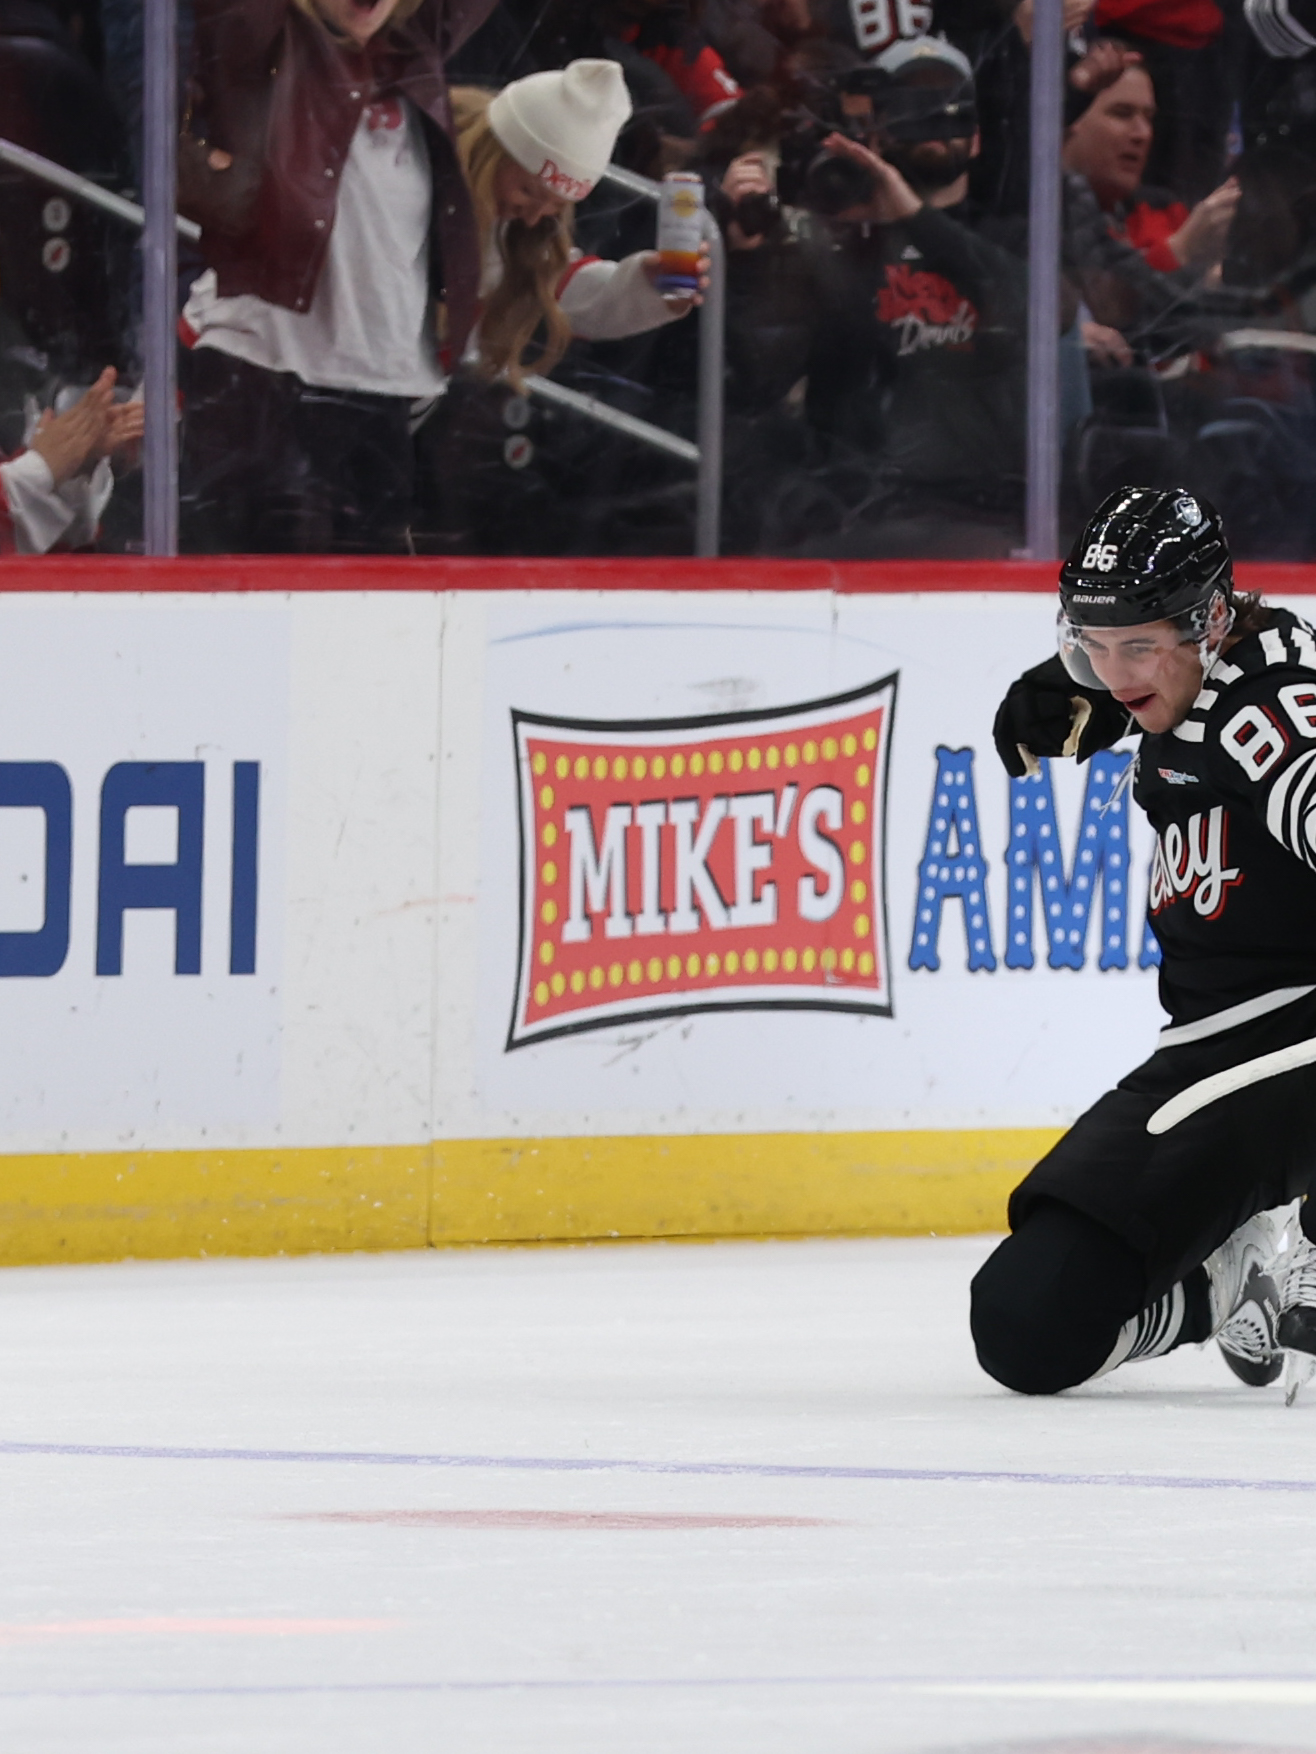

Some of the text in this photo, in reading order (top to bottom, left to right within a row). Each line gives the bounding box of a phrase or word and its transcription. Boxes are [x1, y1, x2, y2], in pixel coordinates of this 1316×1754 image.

[1082, 543, 1118, 573] 86
[1072, 594, 1117, 605] BAUER
[561, 782, 846, 944] MIKE'S
